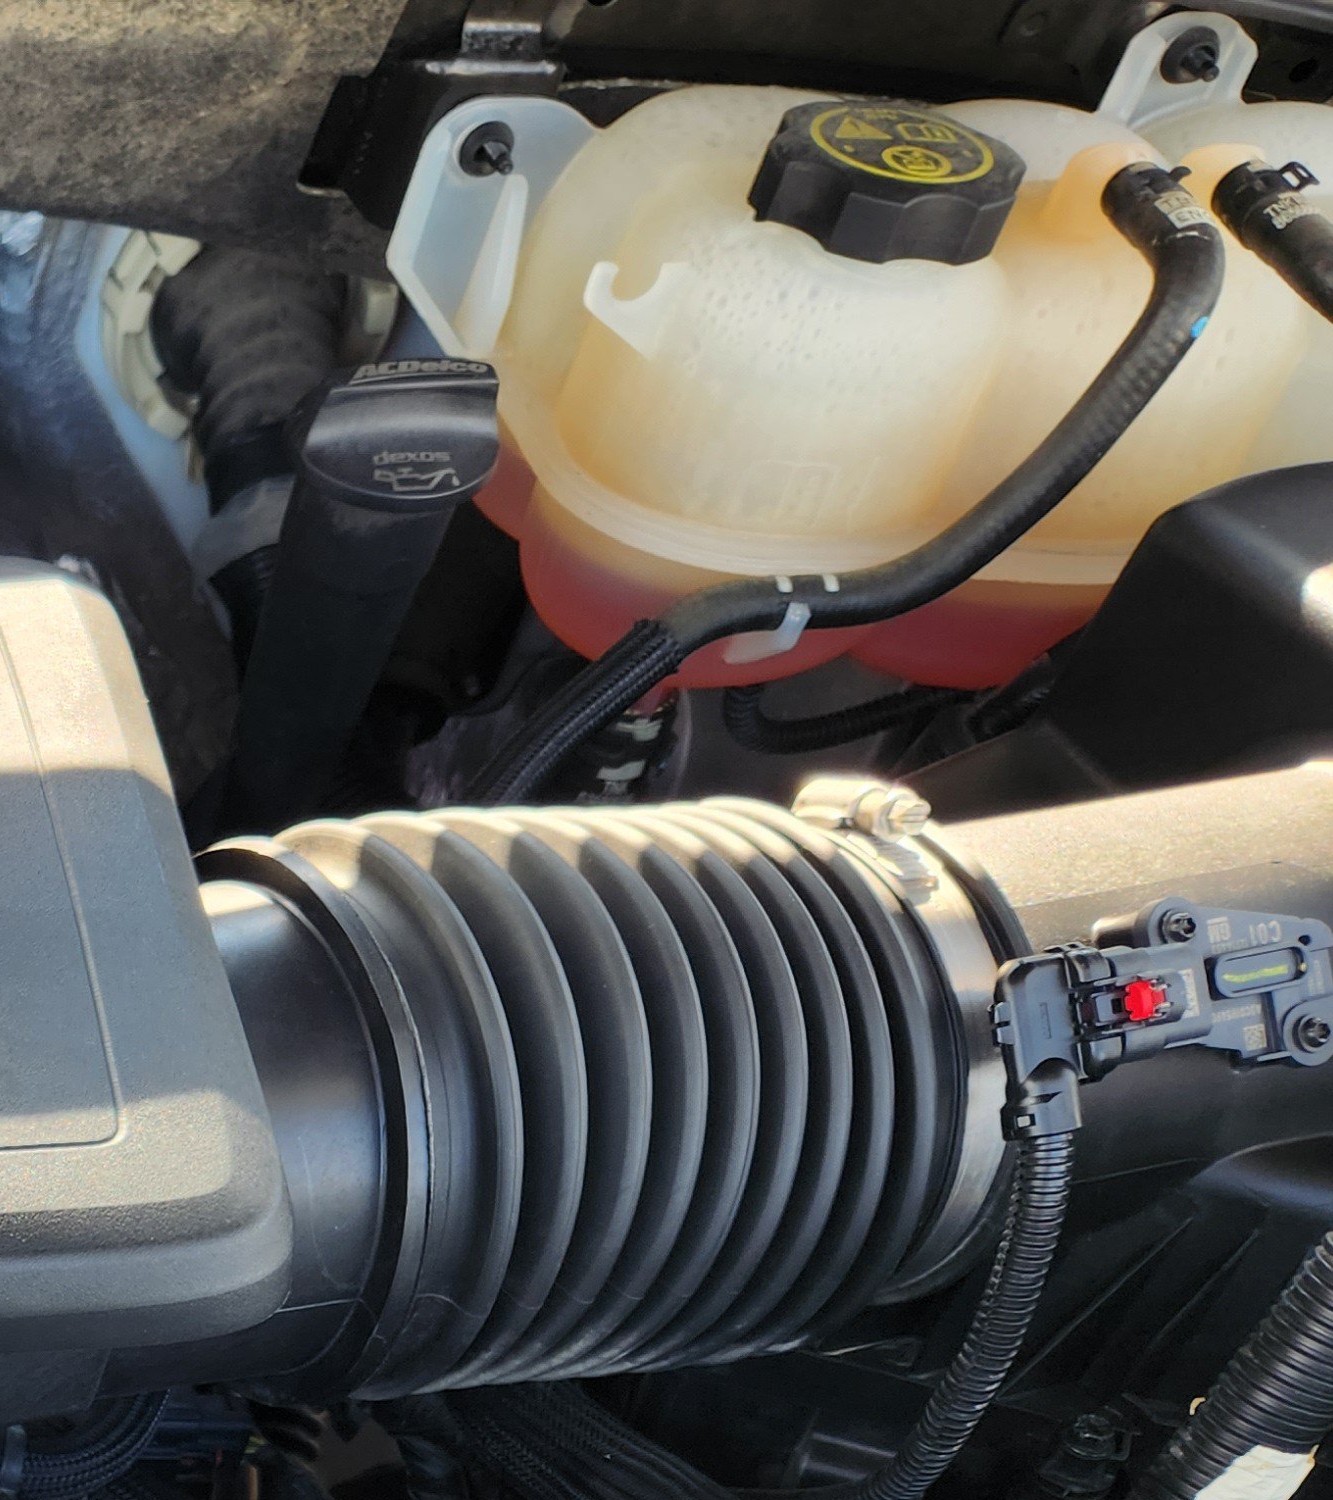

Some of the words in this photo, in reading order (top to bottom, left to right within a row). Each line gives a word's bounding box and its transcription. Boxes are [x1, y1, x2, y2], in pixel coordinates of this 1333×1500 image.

[356, 359, 487, 378] ACDelco
[373, 452, 451, 465] dexos
[1207, 918, 1230, 943] GM
